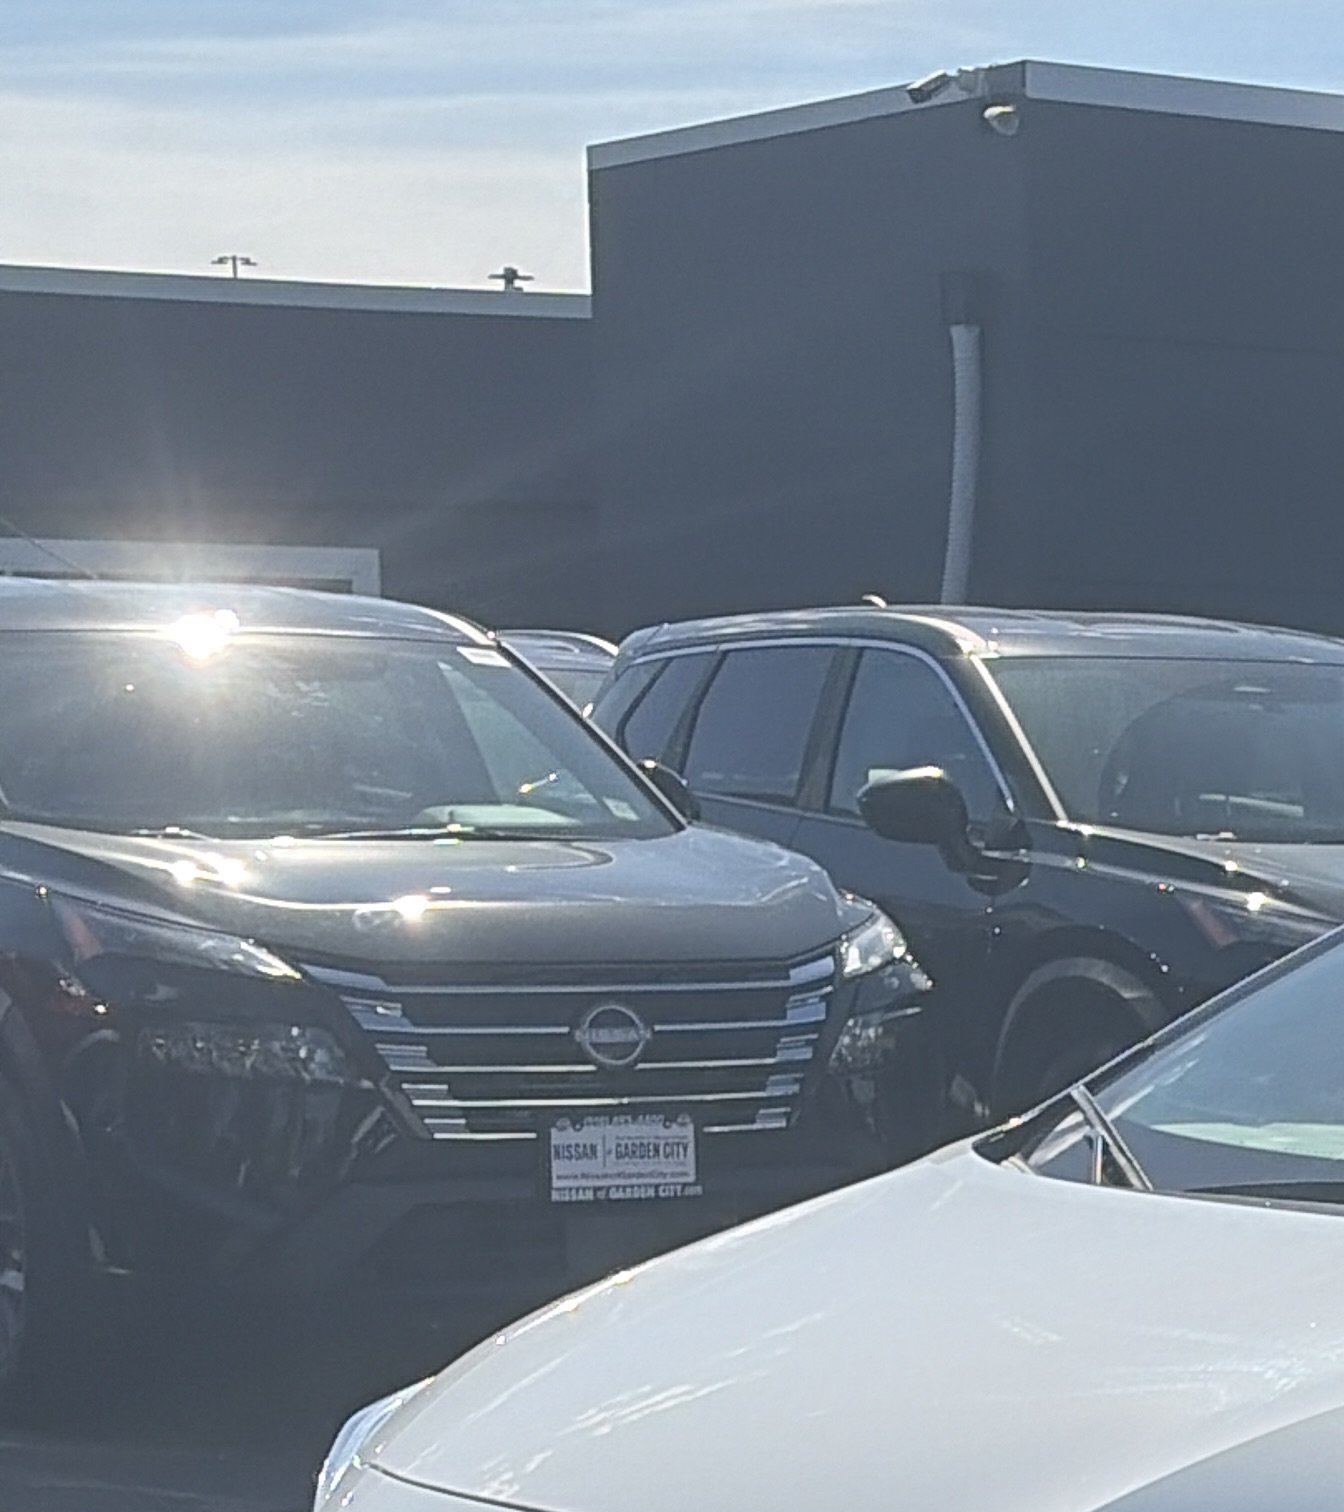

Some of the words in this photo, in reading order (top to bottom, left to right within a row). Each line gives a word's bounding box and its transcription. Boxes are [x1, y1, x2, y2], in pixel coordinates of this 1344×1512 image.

[552, 1143, 599, 1161] NISSAN
[615, 1142, 660, 1160] GARDEN
[663, 1141, 689, 1160] CITY
[550, 1187, 594, 1202] NISSAN
[609, 1186, 655, 1200] GARDEN
